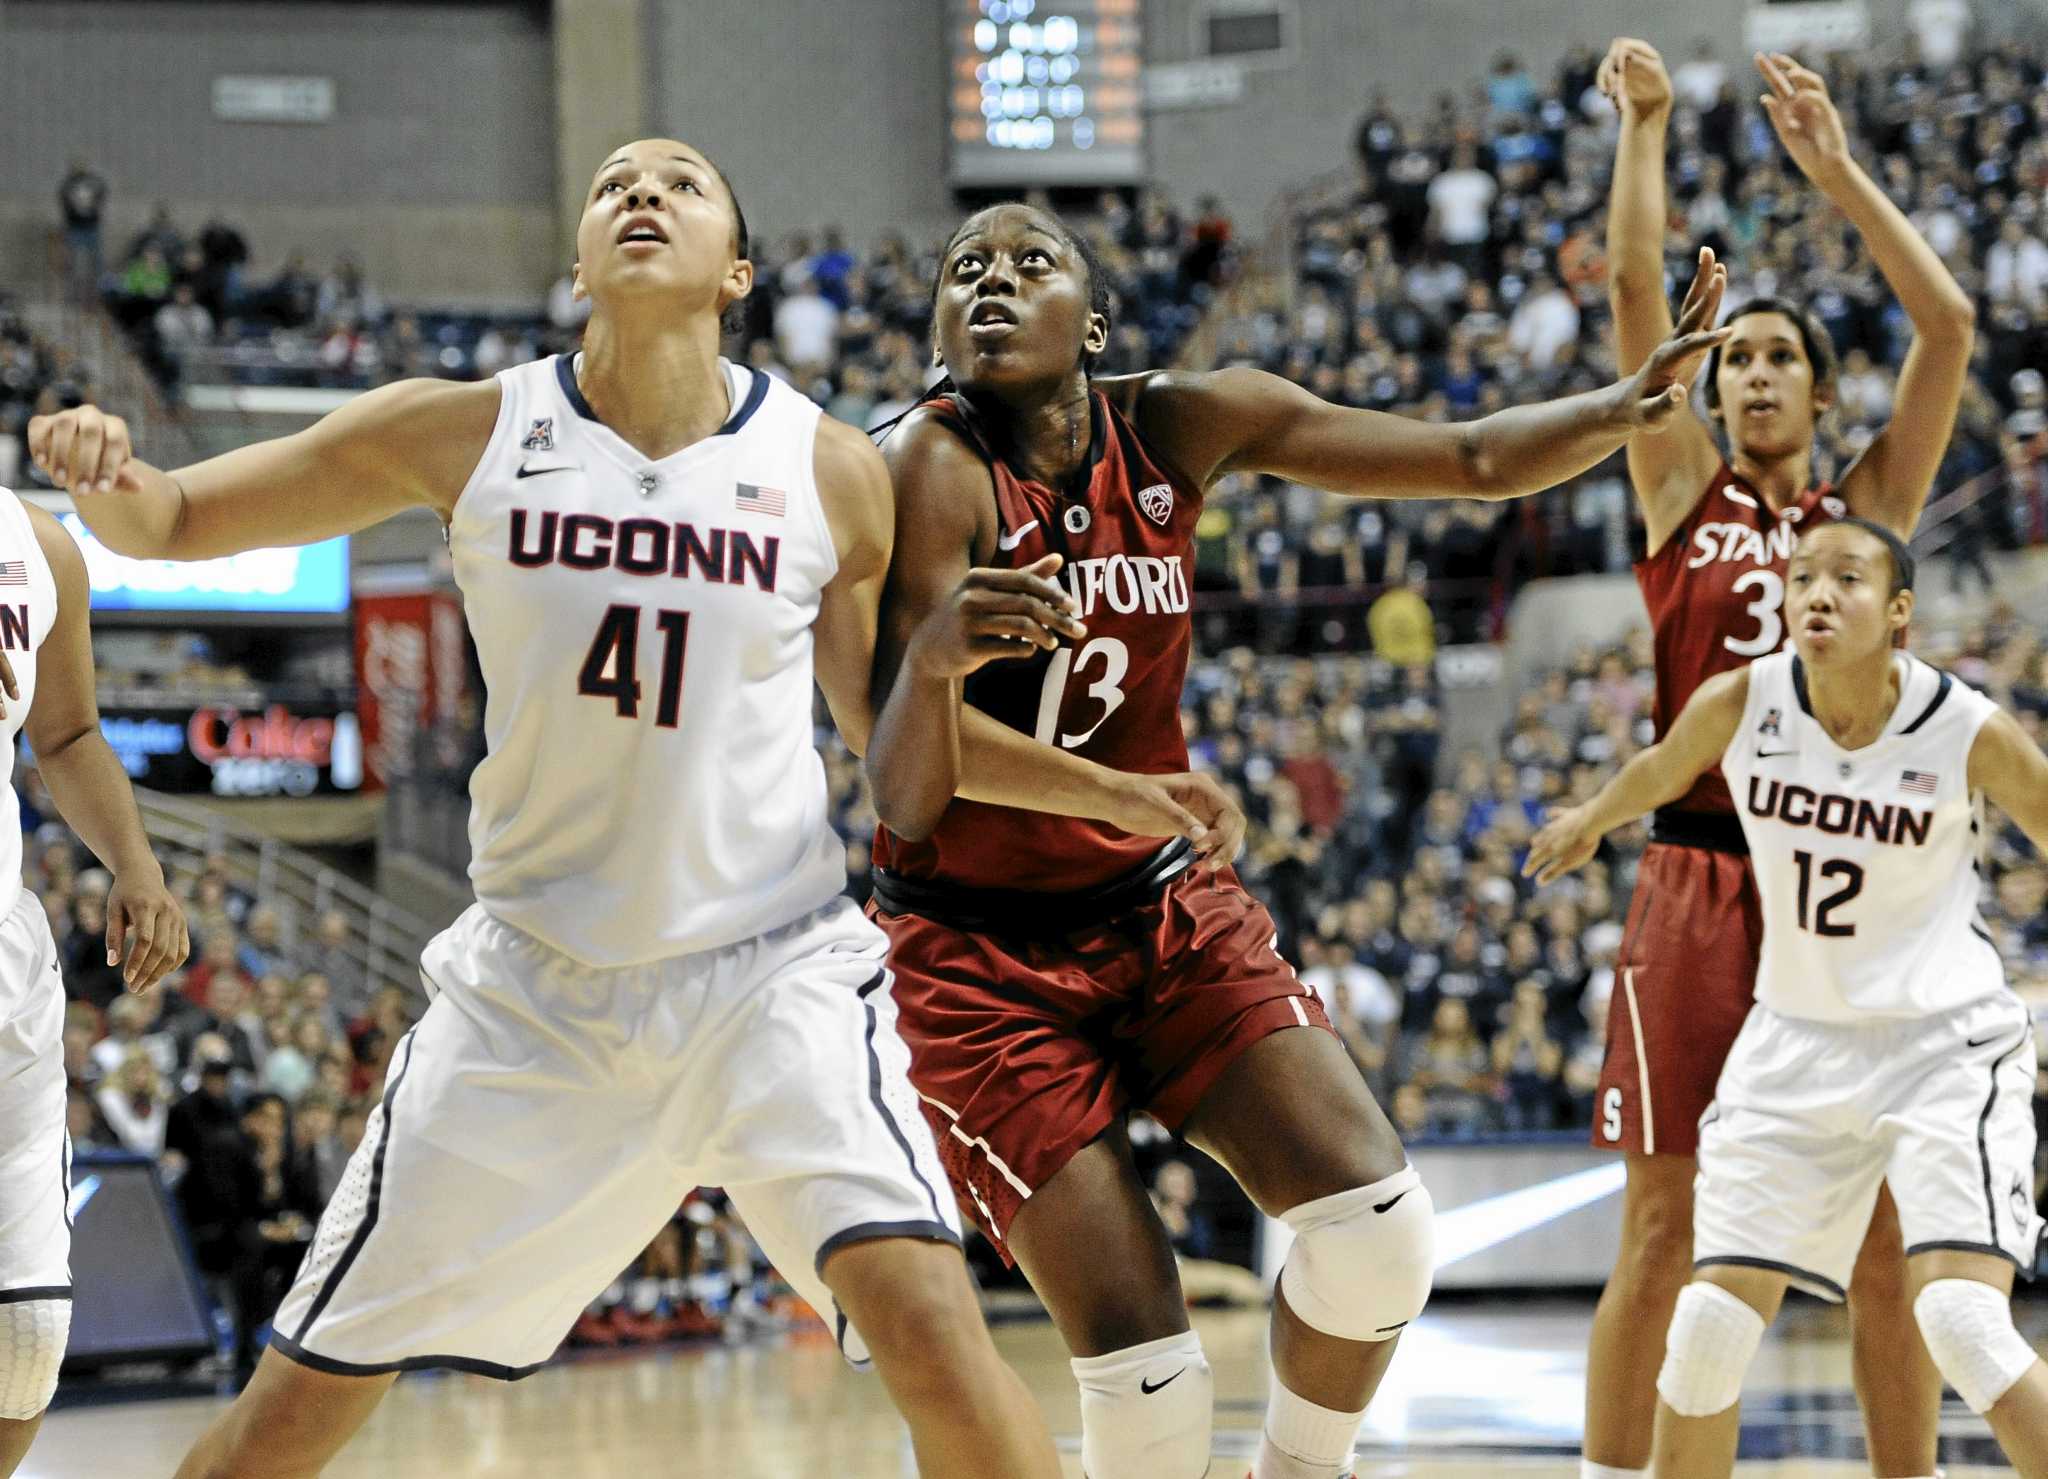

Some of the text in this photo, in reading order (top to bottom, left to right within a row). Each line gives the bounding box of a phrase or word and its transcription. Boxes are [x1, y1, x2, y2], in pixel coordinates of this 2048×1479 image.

[508, 508, 780, 594] UCONN
[1687, 520, 1799, 568] STAN
[1046, 553, 1190, 620] NFORD
[577, 603, 691, 730] 41
[1034, 636, 1129, 749] 13
[1747, 775, 1935, 847] UCONN
[1793, 848, 1865, 938] 12
[1602, 1087, 1623, 1142] S
